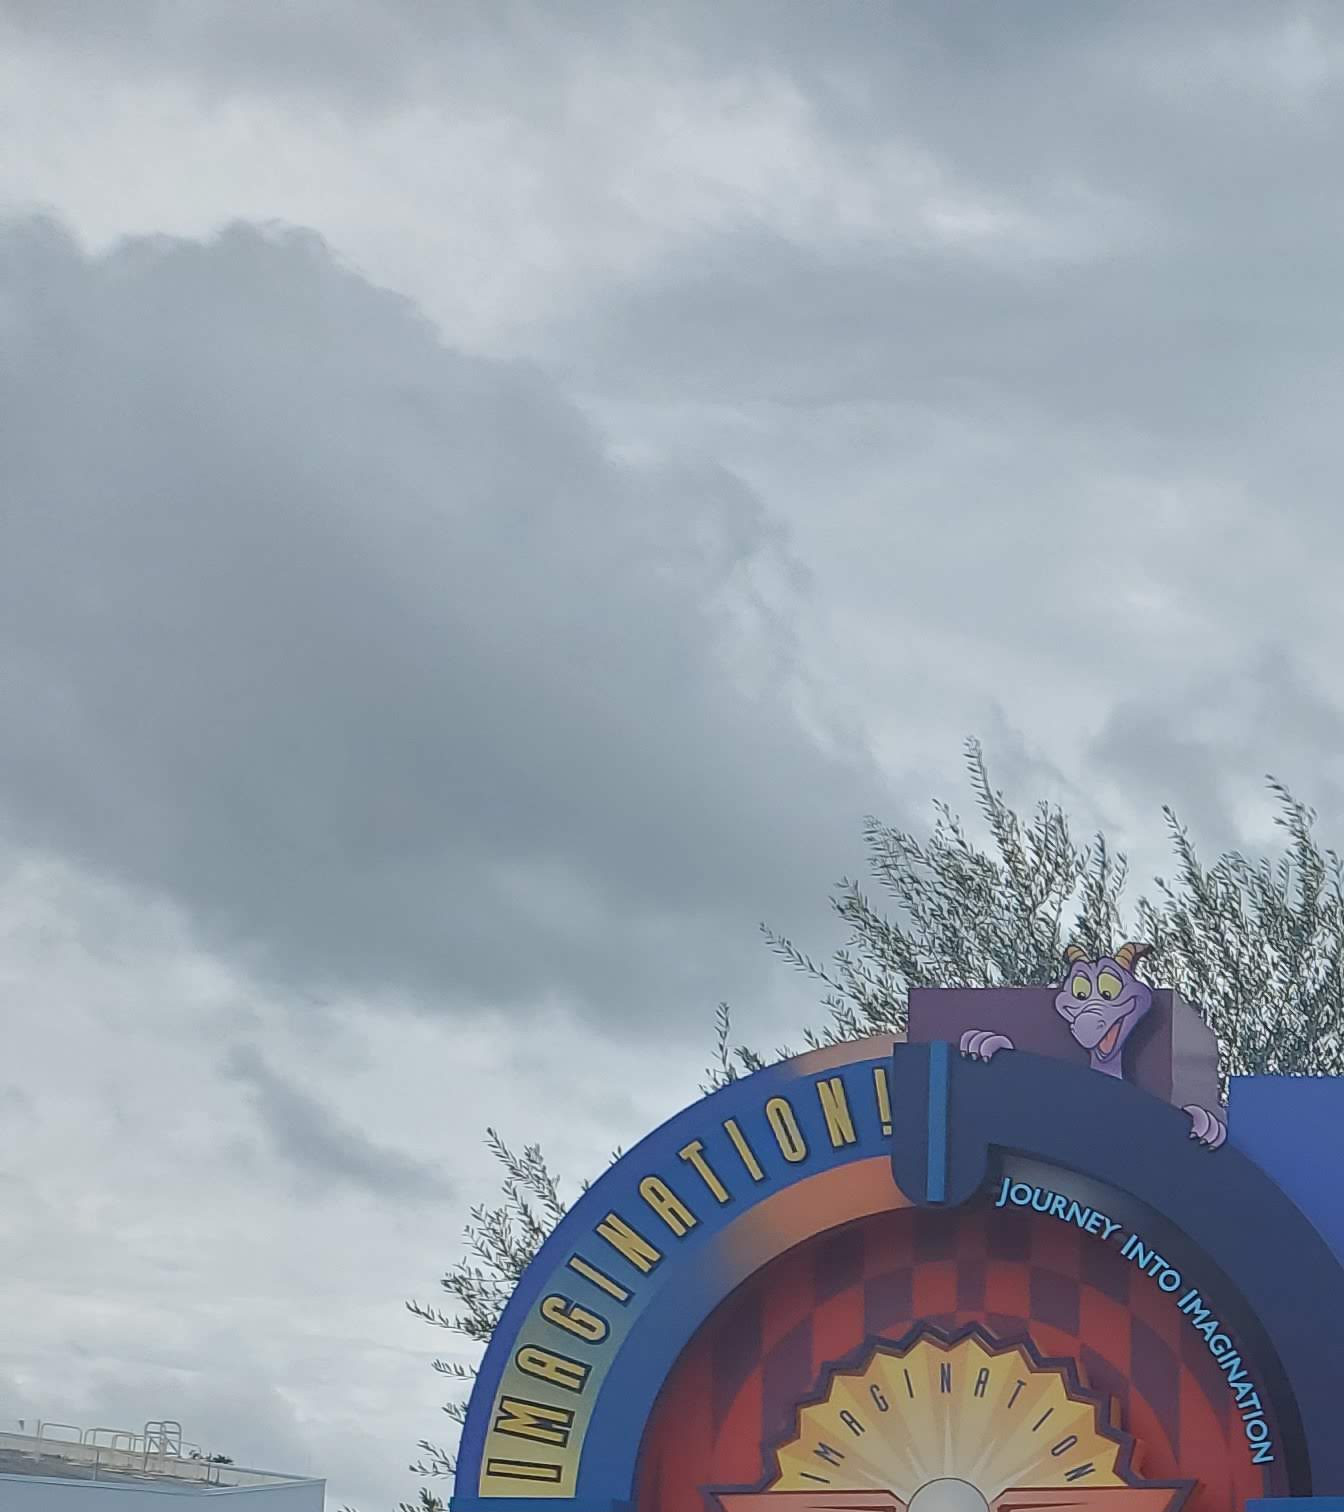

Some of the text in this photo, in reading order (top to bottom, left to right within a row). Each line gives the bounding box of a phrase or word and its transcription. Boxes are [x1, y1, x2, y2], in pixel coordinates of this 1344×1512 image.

[485, 1066, 894, 1484] IMAGINATION!
[995, 1176, 1275, 1465] JOURNEY INTO IMAGINATION
[800, 1362, 1096, 1484] IMAGINATION
